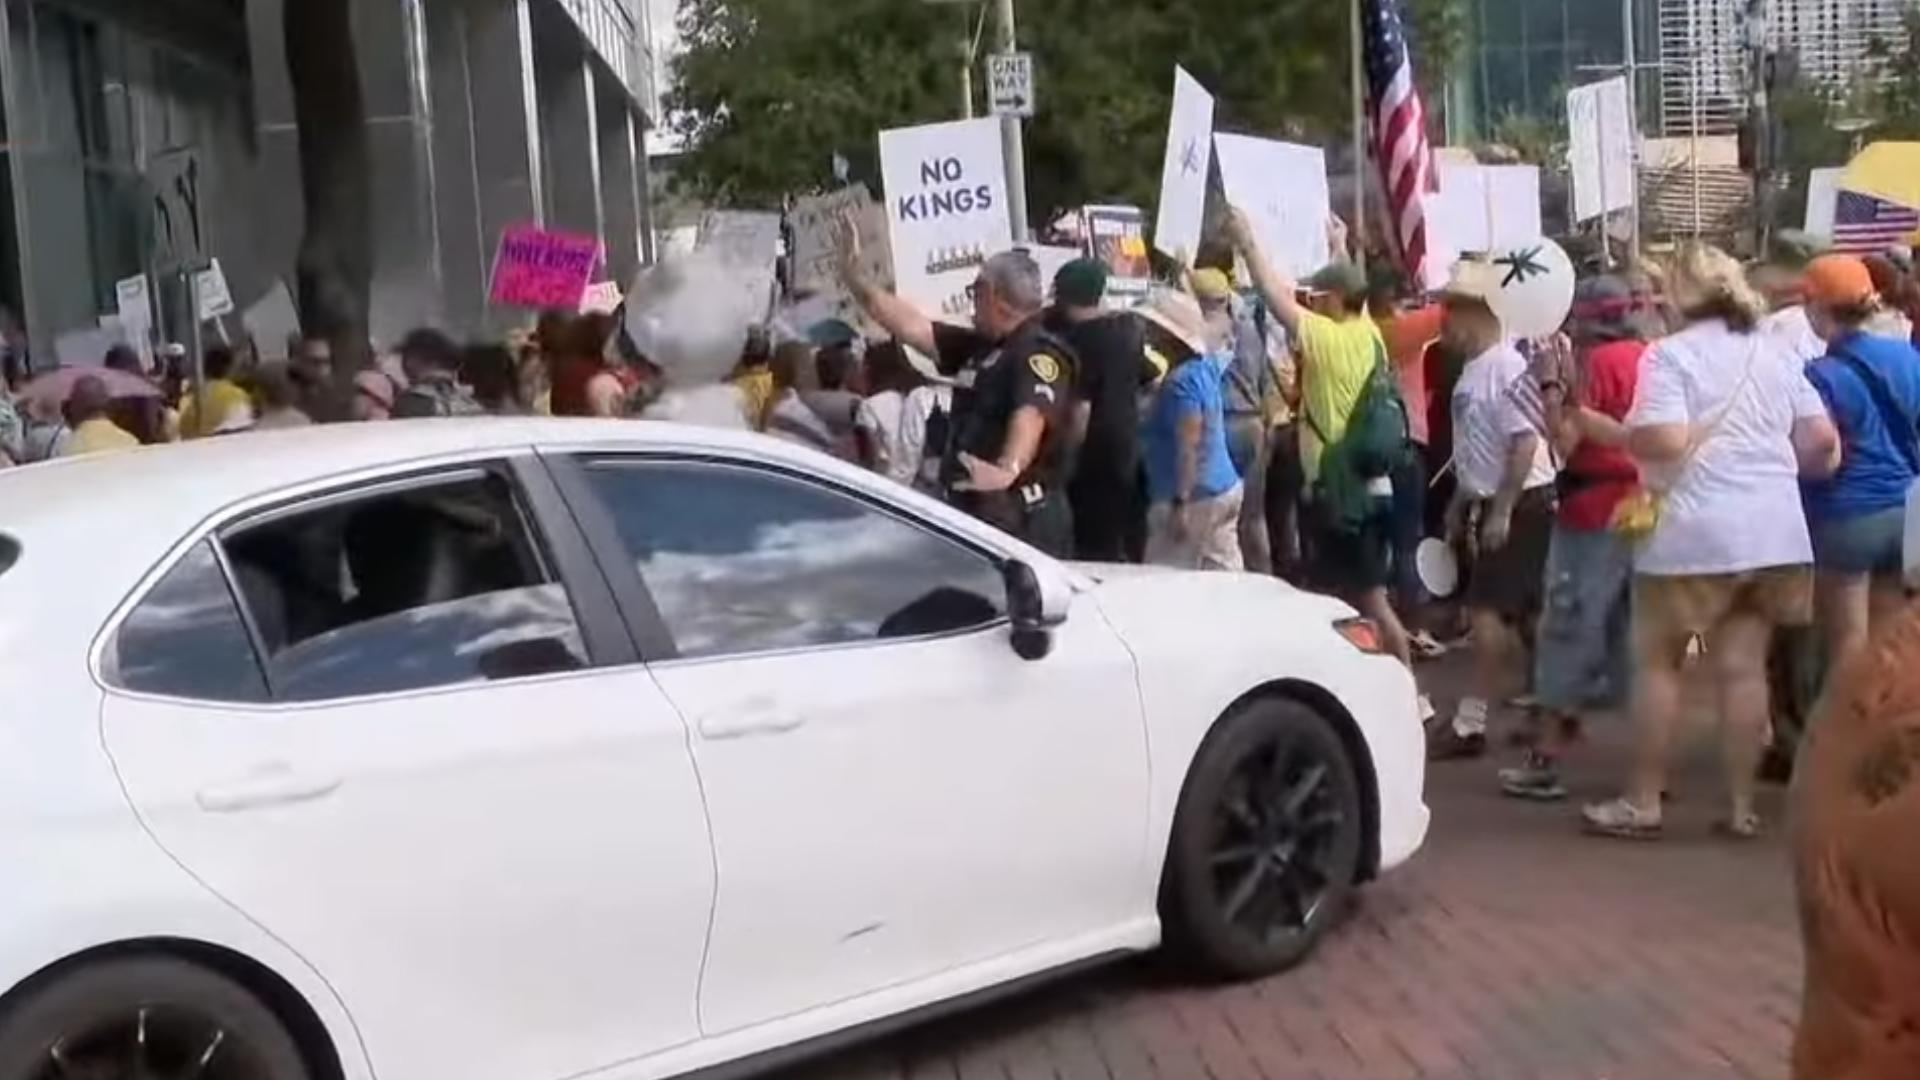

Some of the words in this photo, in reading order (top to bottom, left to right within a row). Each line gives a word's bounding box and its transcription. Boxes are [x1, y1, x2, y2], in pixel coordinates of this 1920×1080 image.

[993, 59, 1025, 73] ONE
[994, 75, 1026, 89] WAY
[920, 157, 962, 186] NO
[898, 185, 992, 221] KINGS
